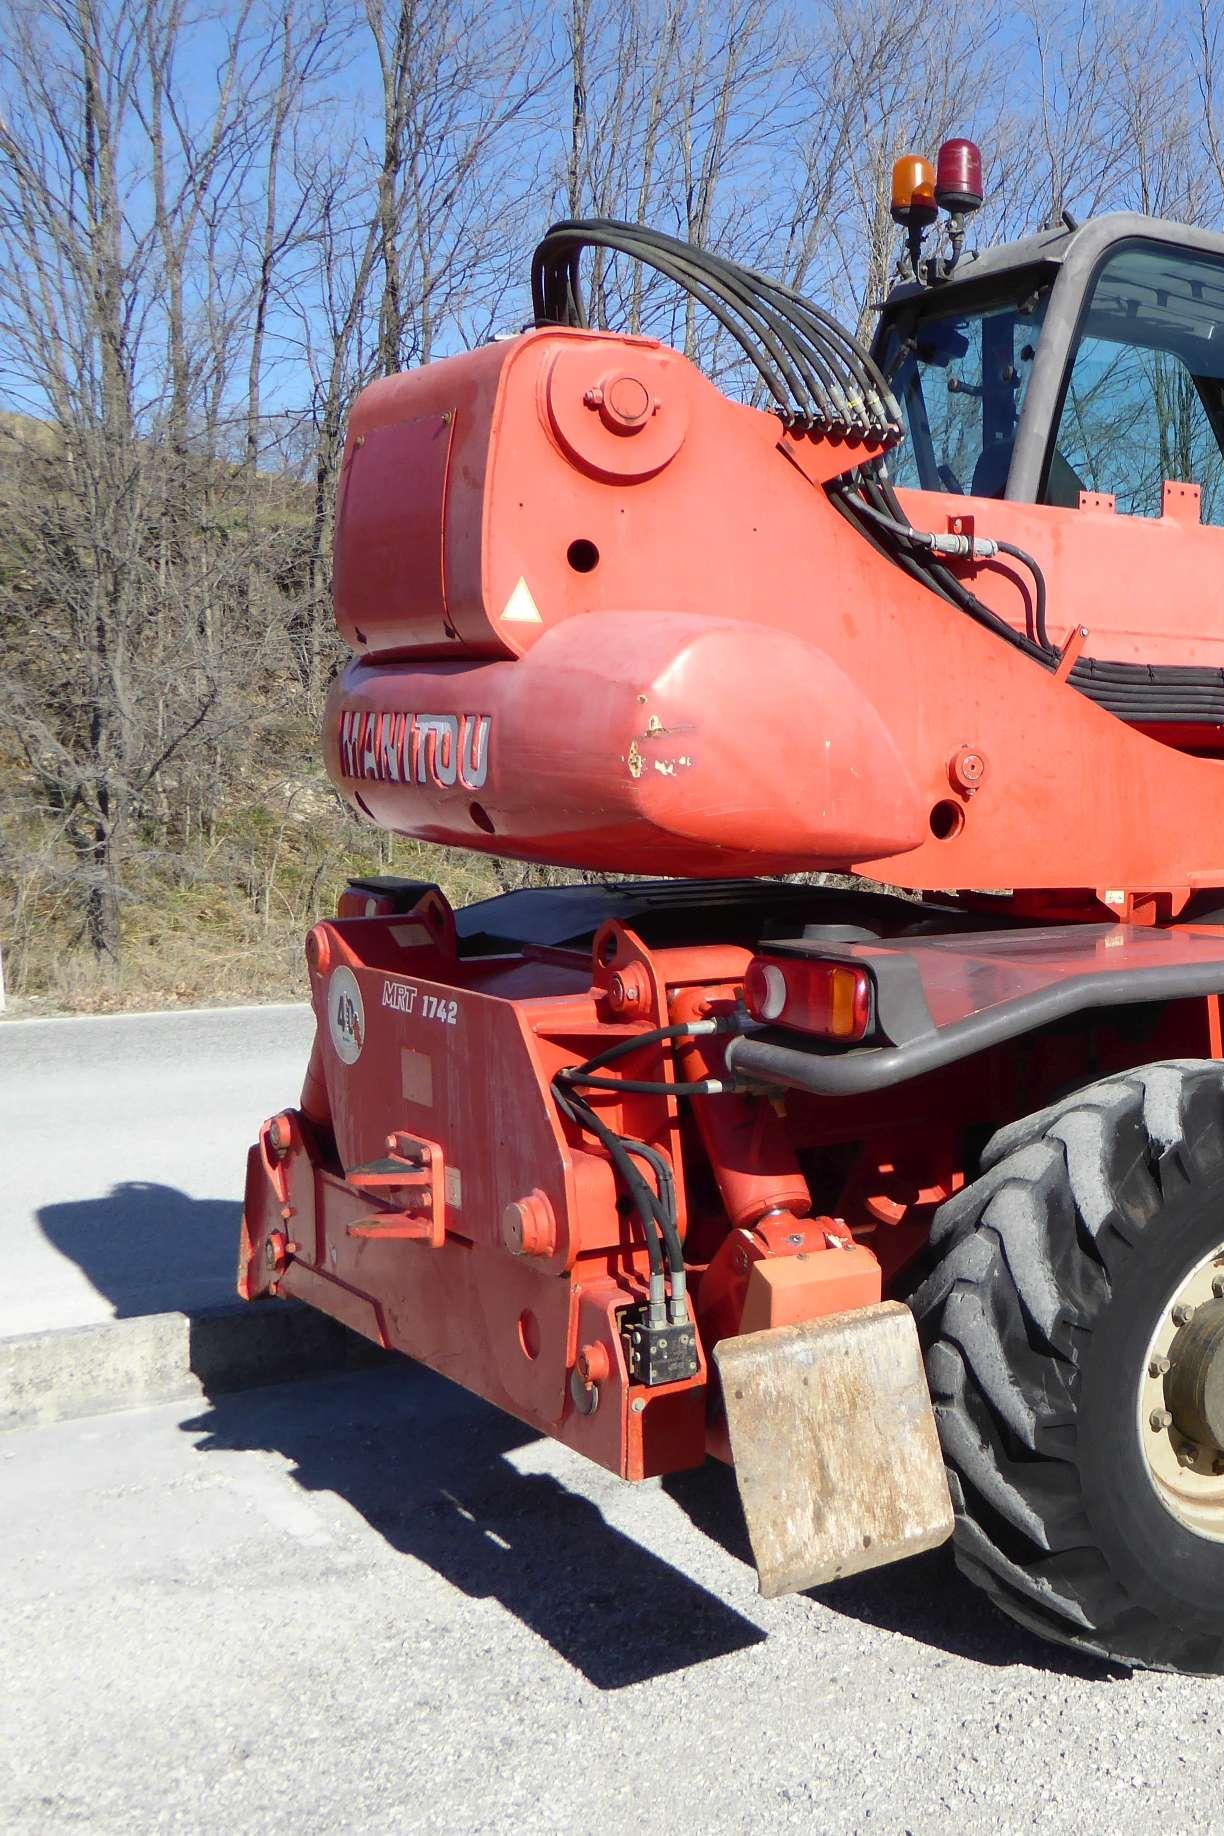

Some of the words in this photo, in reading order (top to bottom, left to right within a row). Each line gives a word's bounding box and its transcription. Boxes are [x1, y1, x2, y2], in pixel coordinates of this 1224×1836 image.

[339, 711, 492, 788] MANITOU
[382, 980, 417, 1013] MRT
[422, 995, 458, 1025] 1742
